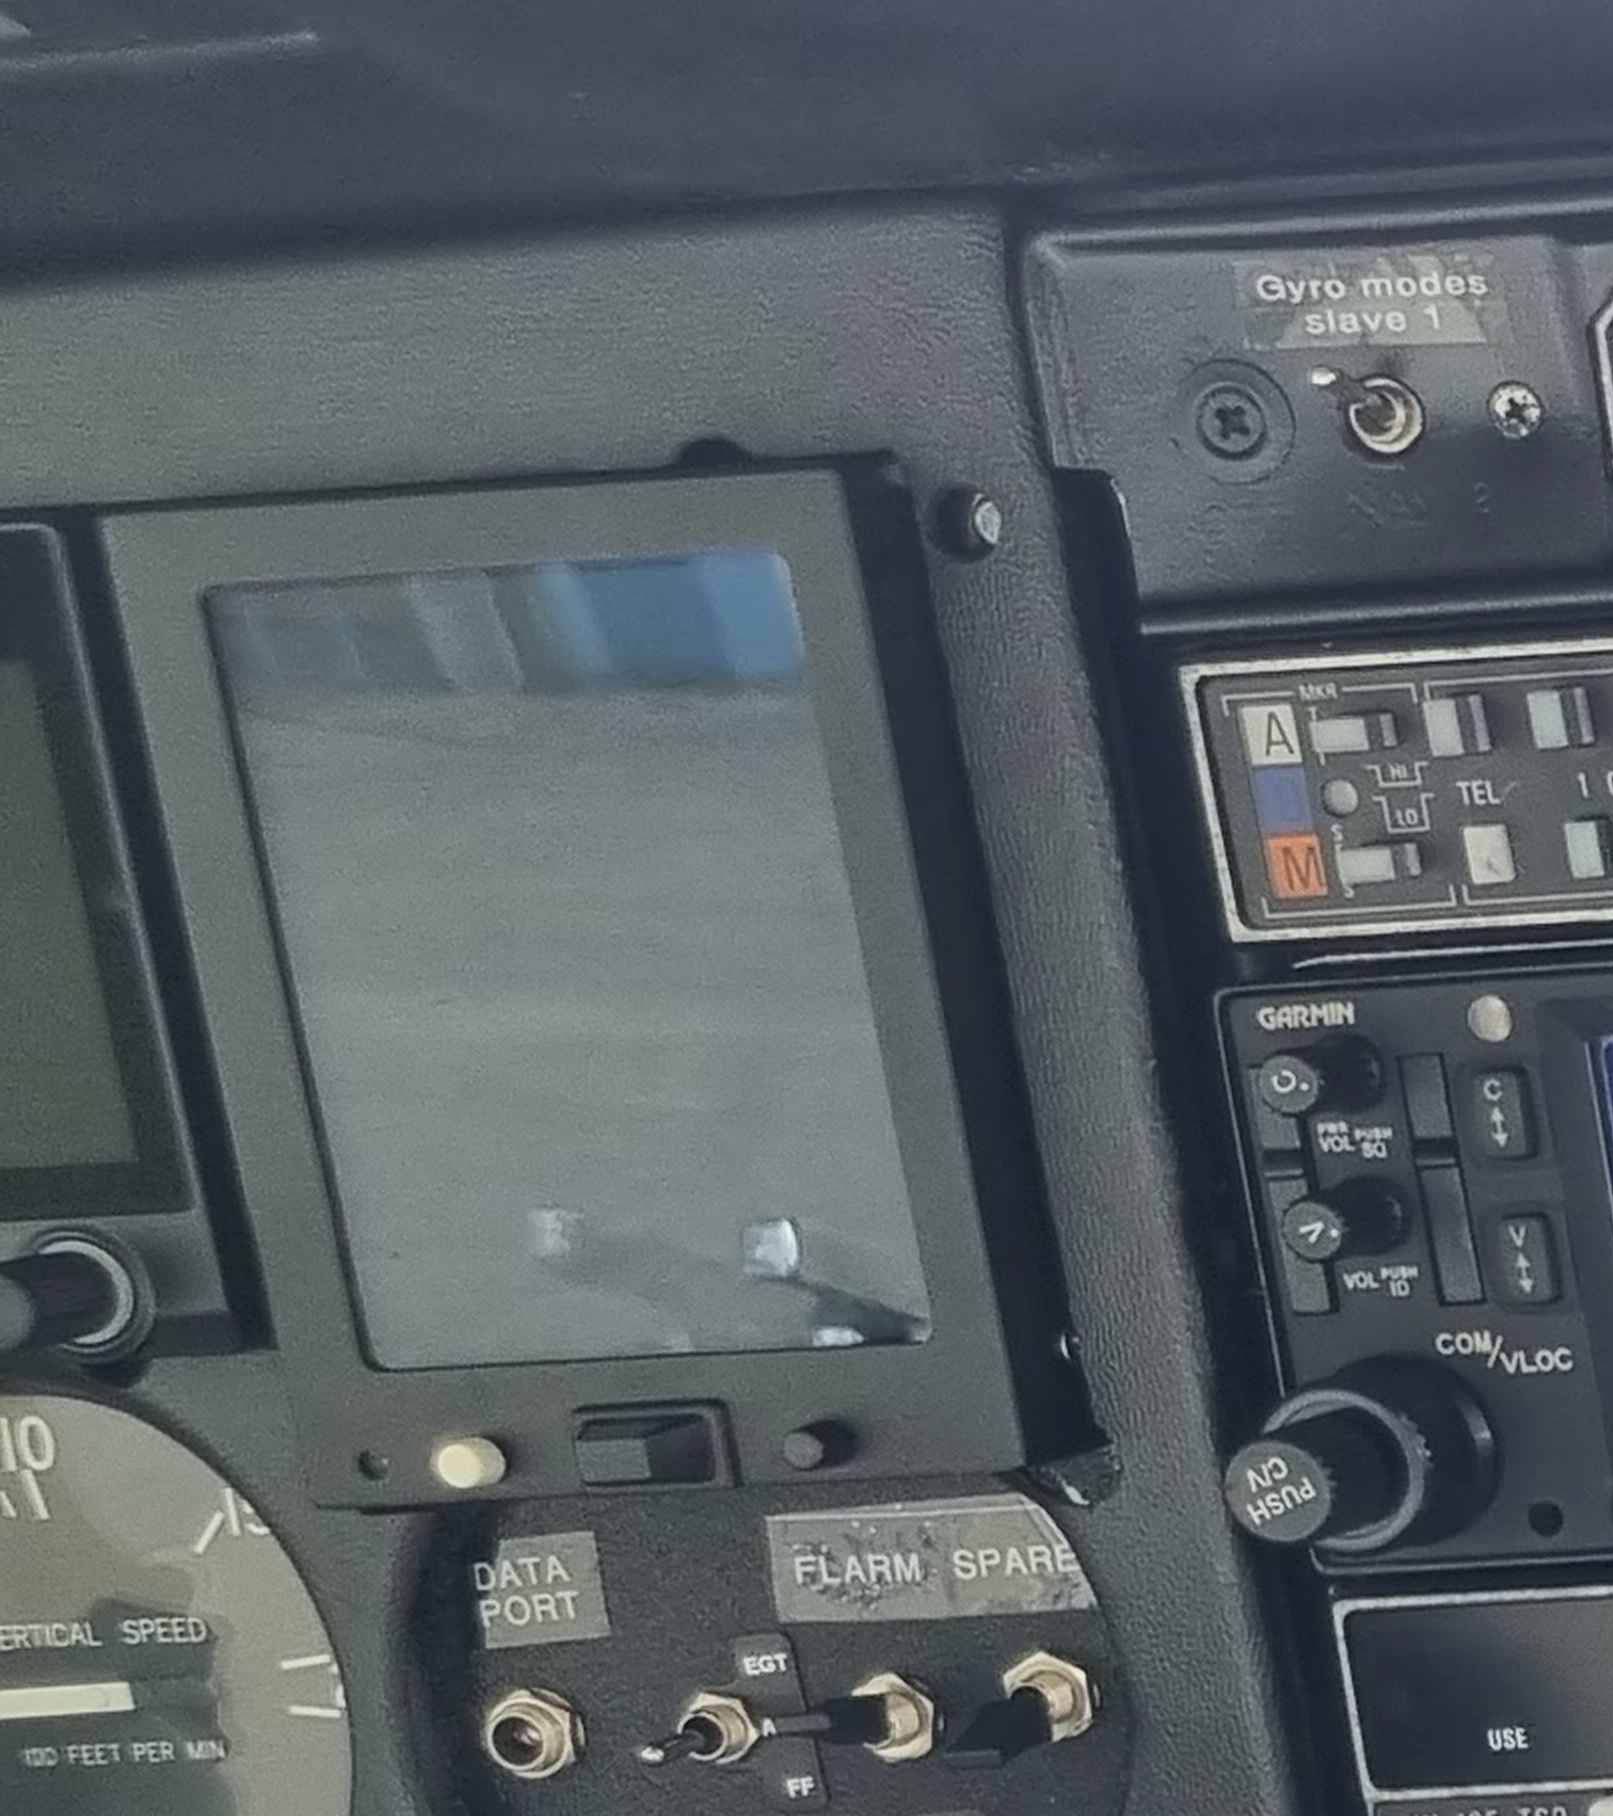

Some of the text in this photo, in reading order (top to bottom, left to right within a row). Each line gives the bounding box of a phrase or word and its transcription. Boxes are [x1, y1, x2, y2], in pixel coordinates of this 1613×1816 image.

[1256, 270, 1488, 304] Gyro modes
[1305, 305, 1441, 336] slave 1
[1457, 782, 1499, 805] TEL
[1258, 1001, 1355, 1031] GARMIN
[474, 1555, 570, 1591] DATA
[794, 1546, 1078, 1586] FLARM SPARE
[480, 1592, 579, 1626] PORT
[122, 1616, 206, 1645] SPEED
[744, 1653, 788, 1676] EGT
[1488, 1728, 1529, 1751] USE
[786, 1776, 816, 1798] FF
